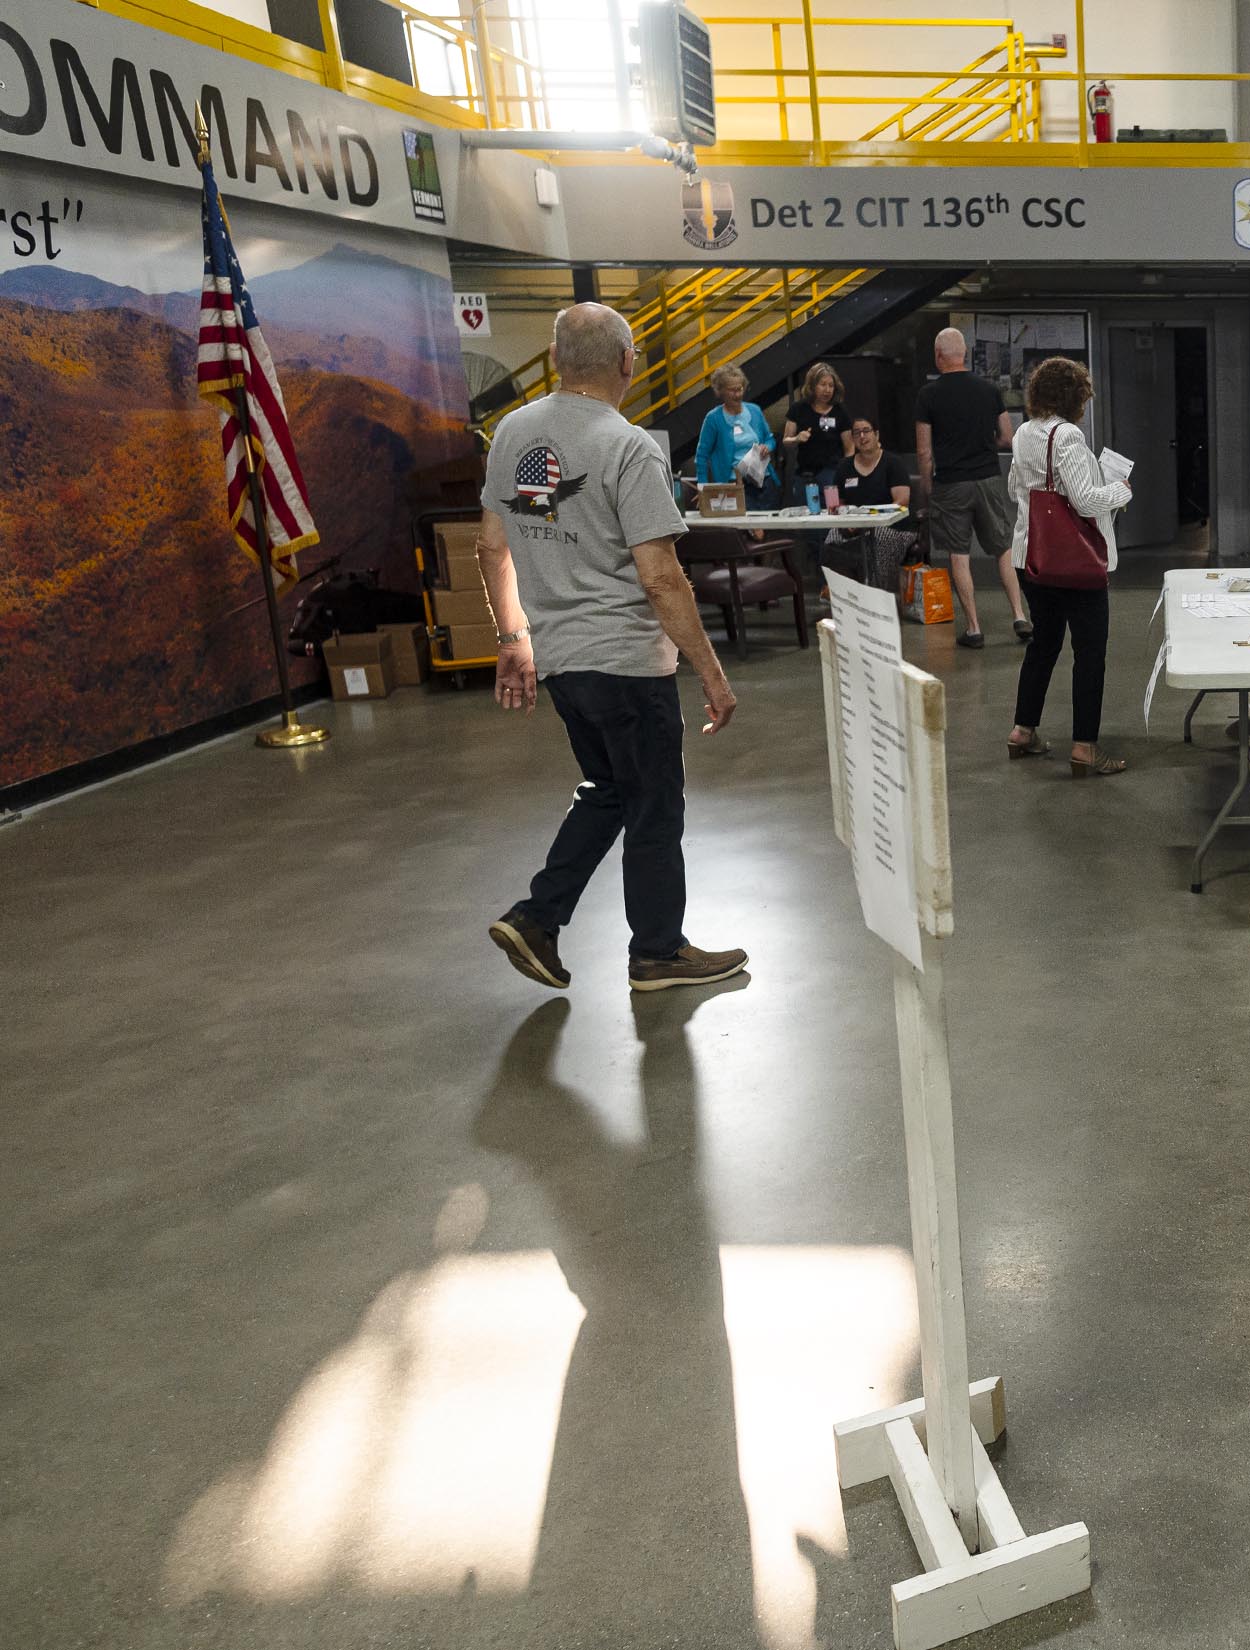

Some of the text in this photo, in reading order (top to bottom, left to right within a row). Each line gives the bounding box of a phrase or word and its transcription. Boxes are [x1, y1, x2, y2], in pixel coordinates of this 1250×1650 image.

[750, 193, 1086, 228] Det 2 CIT 136th CSC
[460, 296, 482, 306] AED
